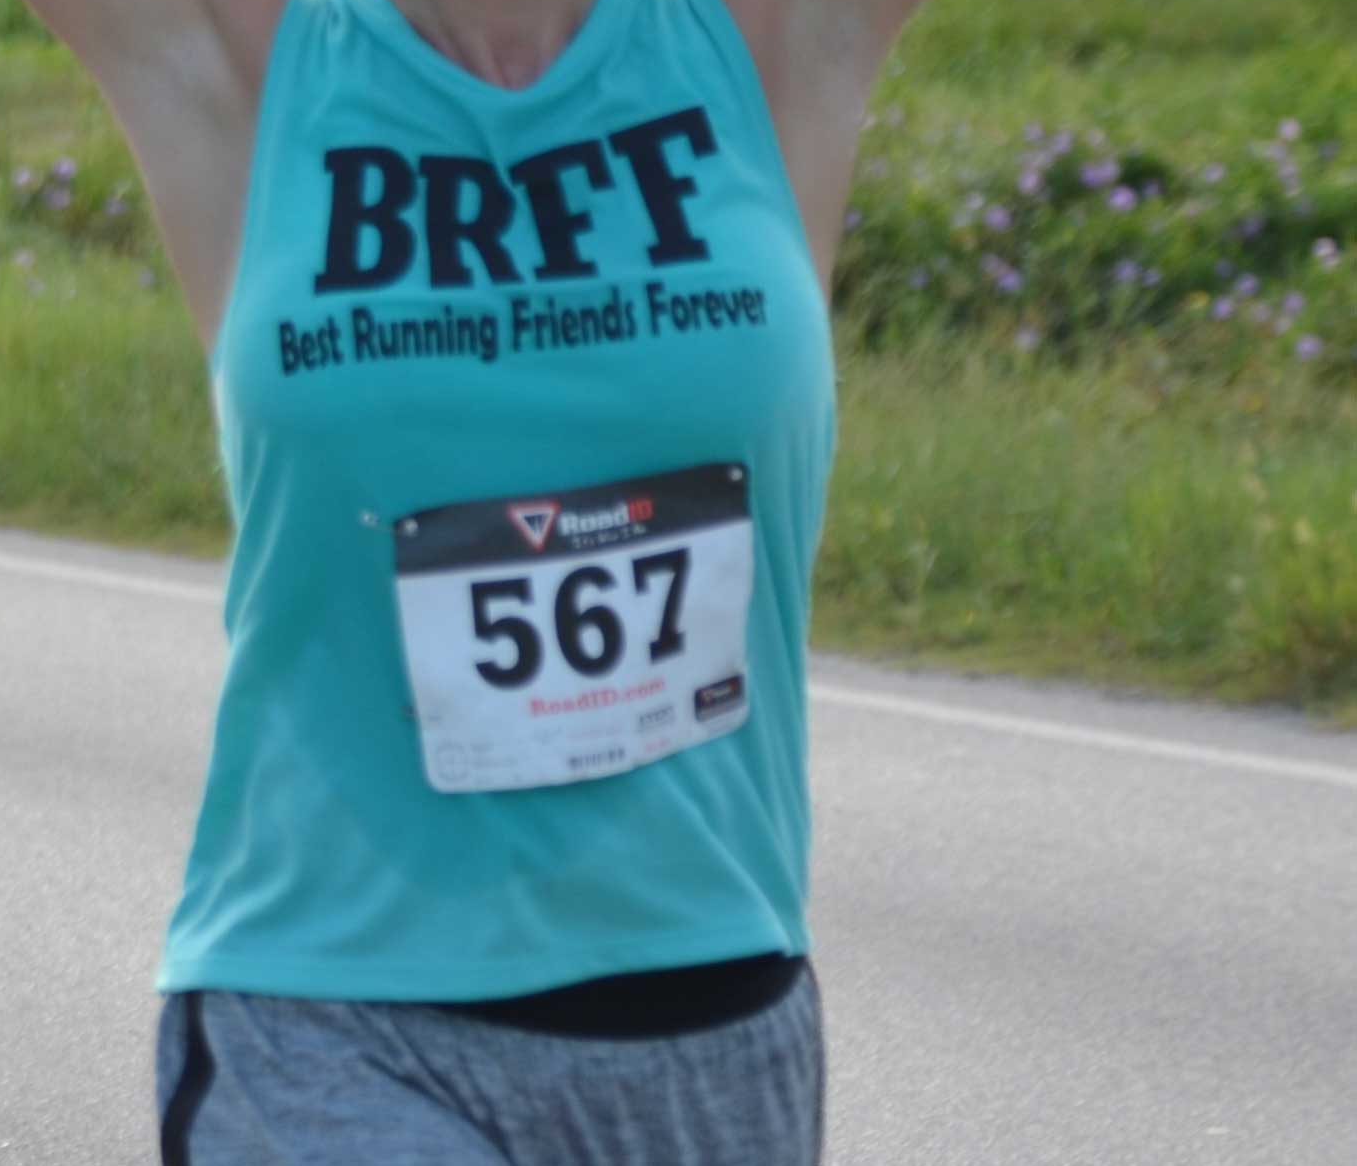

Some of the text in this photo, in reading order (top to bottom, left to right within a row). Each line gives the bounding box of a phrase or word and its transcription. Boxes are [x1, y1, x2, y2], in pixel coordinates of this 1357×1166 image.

[314, 105, 719, 296] BRFF
[280, 281, 768, 377] Best Running Friends Forever
[469, 546, 691, 690] 567
